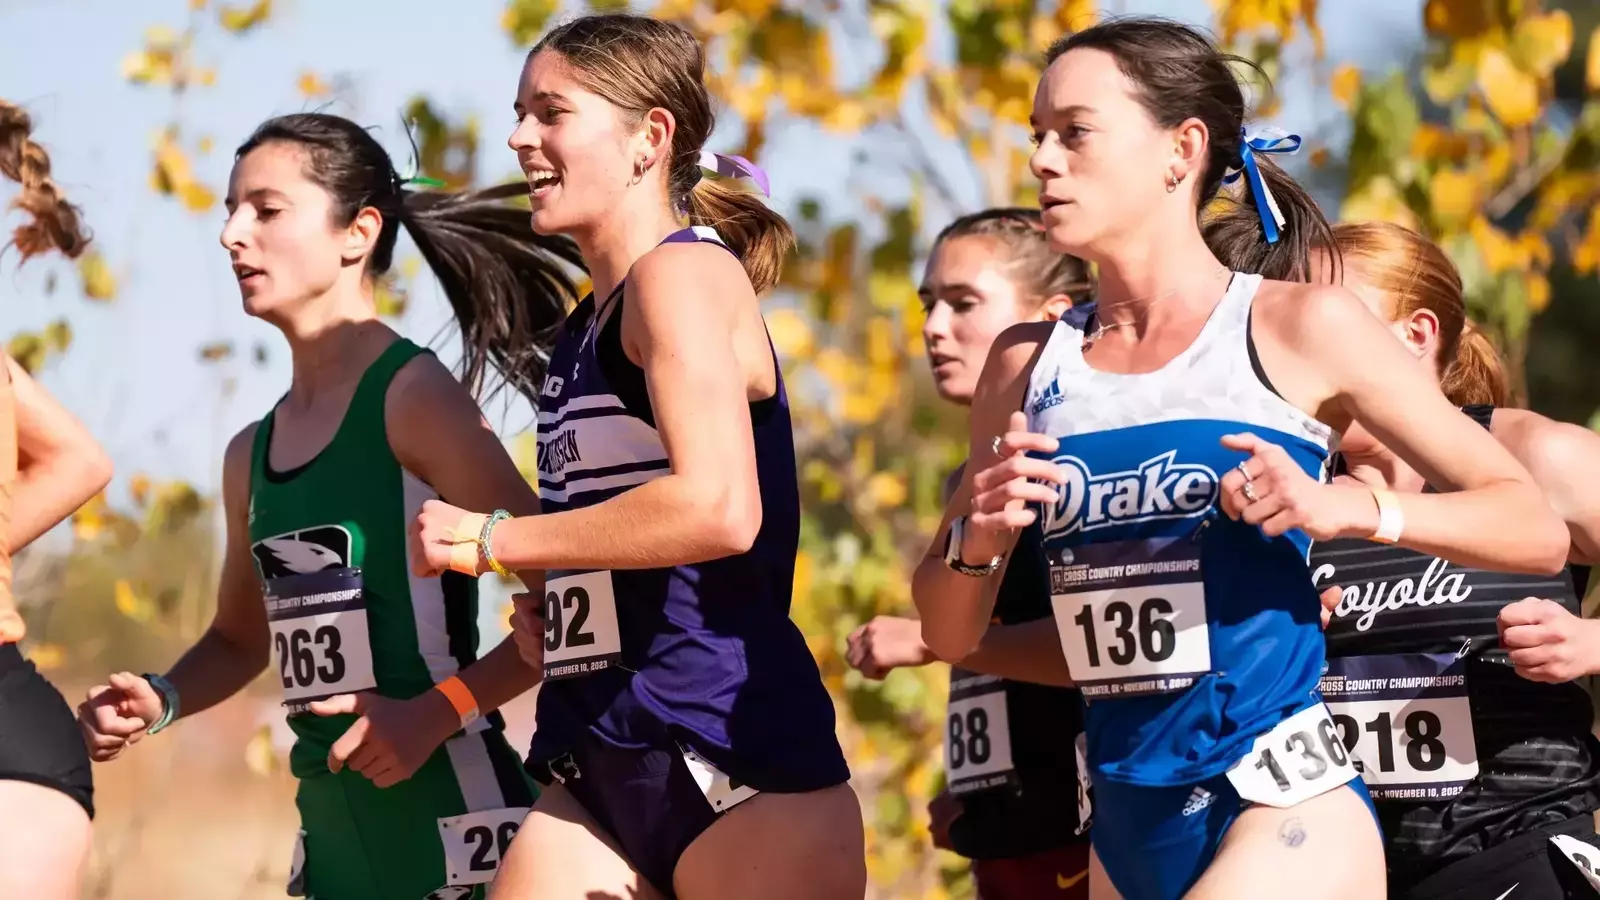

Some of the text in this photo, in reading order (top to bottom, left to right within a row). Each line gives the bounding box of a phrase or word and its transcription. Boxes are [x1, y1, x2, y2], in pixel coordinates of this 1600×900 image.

[1031, 395, 1065, 416] adidas
[1042, 450, 1218, 539] Drake
[1064, 569, 1087, 583] CROSS
[1088, 565, 1124, 580] COUNTRY
[1125, 559, 1200, 577] CHAMPIONSHIPS
[302, 589, 362, 606] CHAMPIONSHIPS
[545, 586, 595, 652] 92
[1074, 598, 1176, 668] 136
[275, 625, 346, 689] 263
[550, 664, 580, 677] NOVEMBER
[580, 662, 590, 673] 10,
[590, 660, 608, 671] 2023
[1123, 680, 1156, 693] NOVEMBER
[1318, 675, 1465, 692] ROSS COUNTRY CHAMPIONSHIPS
[1332, 710, 1446, 773] 218
[1254, 718, 1347, 792] 136
[1384, 788, 1426, 799] NOVEMBER
[1427, 787, 1439, 799] 10,
[1181, 795, 1218, 816] adidas
